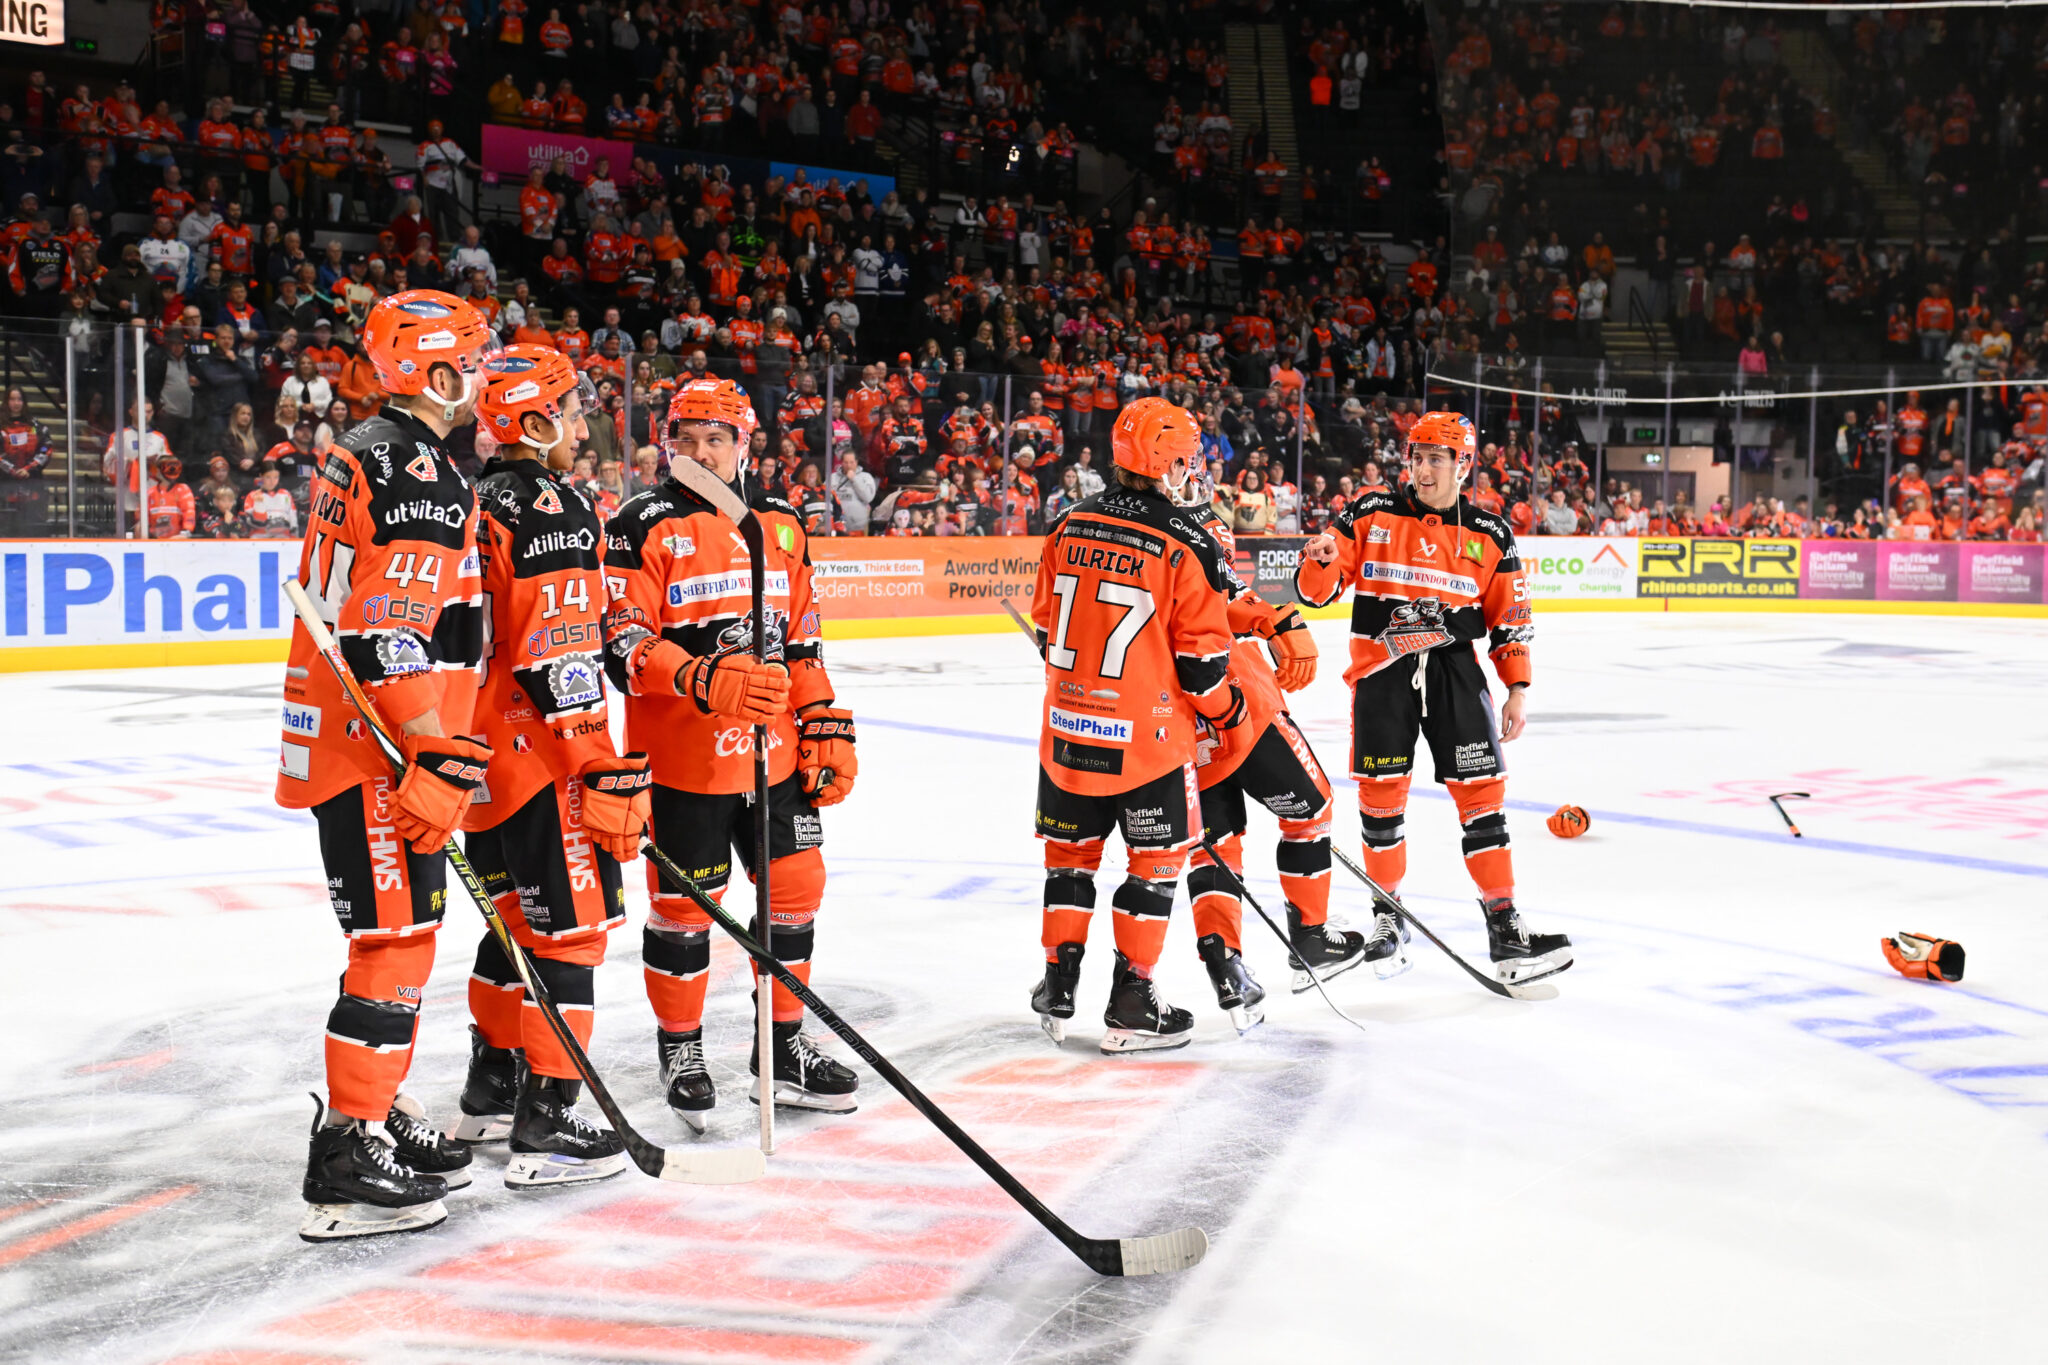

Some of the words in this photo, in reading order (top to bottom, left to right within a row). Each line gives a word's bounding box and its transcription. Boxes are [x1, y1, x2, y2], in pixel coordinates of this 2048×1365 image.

[1360, 496, 1394, 510] ogilvie
[1475, 517, 1505, 539] ogilvie
[523, 530, 580, 559] utilita
[1066, 544, 1146, 578] ULRICK
[1810, 552, 1858, 563] Sheffield
[1889, 553, 1940, 565] Sheffield
[1972, 555, 2024, 567] Sheffield
[384, 553, 442, 594] 44
[829, 563, 862, 575] Years,
[864, 562, 892, 573] Think
[943, 558, 999, 576] Award
[1585, 565, 1627, 579] energy
[1373, 566, 1414, 581] SHEFFIELD
[1414, 571, 1449, 586] WINDOW
[1450, 579, 1478, 594] CENTRE
[1579, 582, 1622, 593] Charging
[683, 578, 738, 598] SHEFFIELD
[816, 580, 924, 598] eden-ts.com
[949, 580, 1020, 599] Provider
[1641, 580, 1796, 596] rhinosports.co.uk
[541, 578, 589, 620] 14
[550, 621, 600, 647] dsn
[1048, 573, 1157, 680] 17
[1393, 630, 1446, 655] STEELERS
[1059, 680, 1086, 698] CRS
[558, 695, 577, 706] JJA
[504, 708, 533, 719] ECHO
[1152, 706, 1173, 714] ECHO
[1052, 711, 1127, 738] SteelPhalt
[1455, 741, 1489, 753] Sheffield
[1377, 757, 1391, 765] MF
[1392, 755, 1408, 764] Hire
[1456, 750, 1484, 760] Hallam
[1456, 755, 1496, 766] University
[1125, 807, 1164, 818] Sheffield
[1043, 816, 1056, 826] MF
[1058, 821, 1078, 831] Hire
[1126, 816, 1156, 826] Hallam
[1127, 822, 1172, 833] University
[368, 825, 403, 892] SMH
[563, 830, 596, 893] SMH
[694, 867, 712, 879] MF
